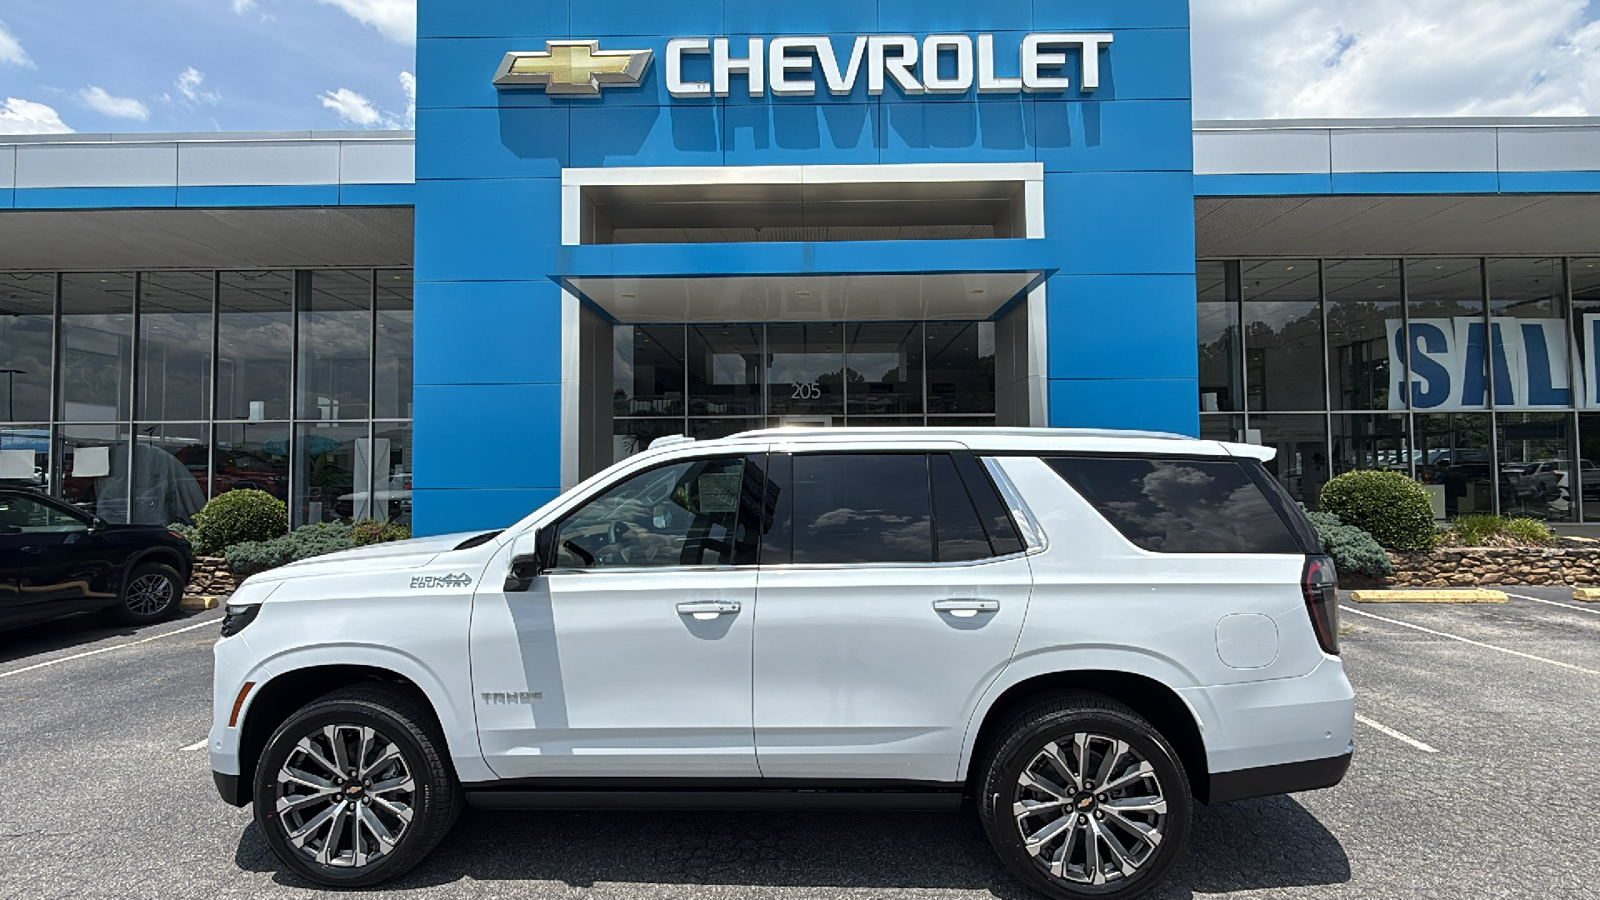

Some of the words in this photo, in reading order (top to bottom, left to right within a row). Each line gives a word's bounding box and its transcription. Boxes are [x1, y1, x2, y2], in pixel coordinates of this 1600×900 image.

[665, 33, 1113, 98] CHEVROLET
[1395, 319, 1600, 408] SAL
[791, 383, 821, 399] 205
[481, 691, 543, 701] TAHOE
